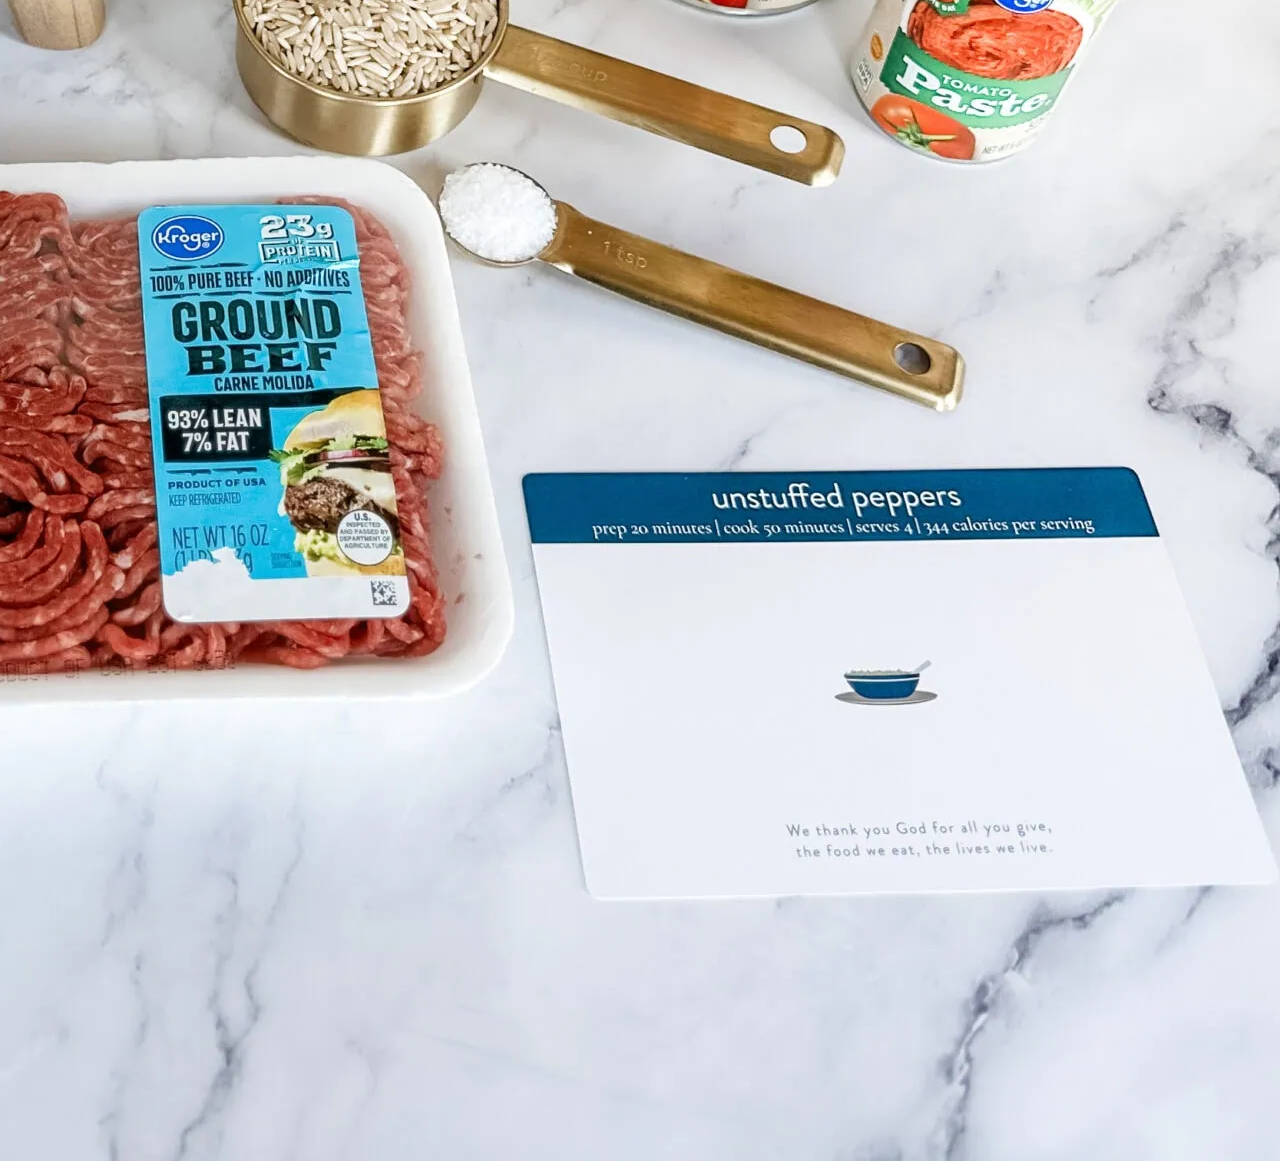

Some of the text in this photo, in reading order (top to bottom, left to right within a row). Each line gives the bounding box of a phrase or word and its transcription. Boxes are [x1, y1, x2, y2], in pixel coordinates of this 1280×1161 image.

[896, 54, 1049, 117] Paste
[942, 74, 1011, 97] TOMATO
[260, 215, 333, 239] 23g
[267, 245, 333, 258] PROTEIN
[150, 267, 351, 292] 100% PURE BEEF NO ADDITIVES
[171, 298, 342, 343] GROUND
[183, 341, 338, 376] BEEF
[214, 375, 314, 391] CARNE MOLIDA
[167, 408, 262, 429] 93% LEAN
[182, 431, 250, 452] 7% FAT
[168, 478, 266, 489] PRODUCT OF USA
[169, 492, 241, 506] KEEP REFRIGERATED
[712, 482, 962, 517] unstuffed peppers
[354, 513, 371, 521] U.S.
[592, 516, 1095, 539] prep 20 minutes cook 50 minutes serves 4 344 calories per serving
[172, 524, 269, 549] NET WT 16 OZ
[786, 820, 1053, 839] We thank you God for all you give,
[796, 840, 1053, 858] the food we eat, the lives we live.
